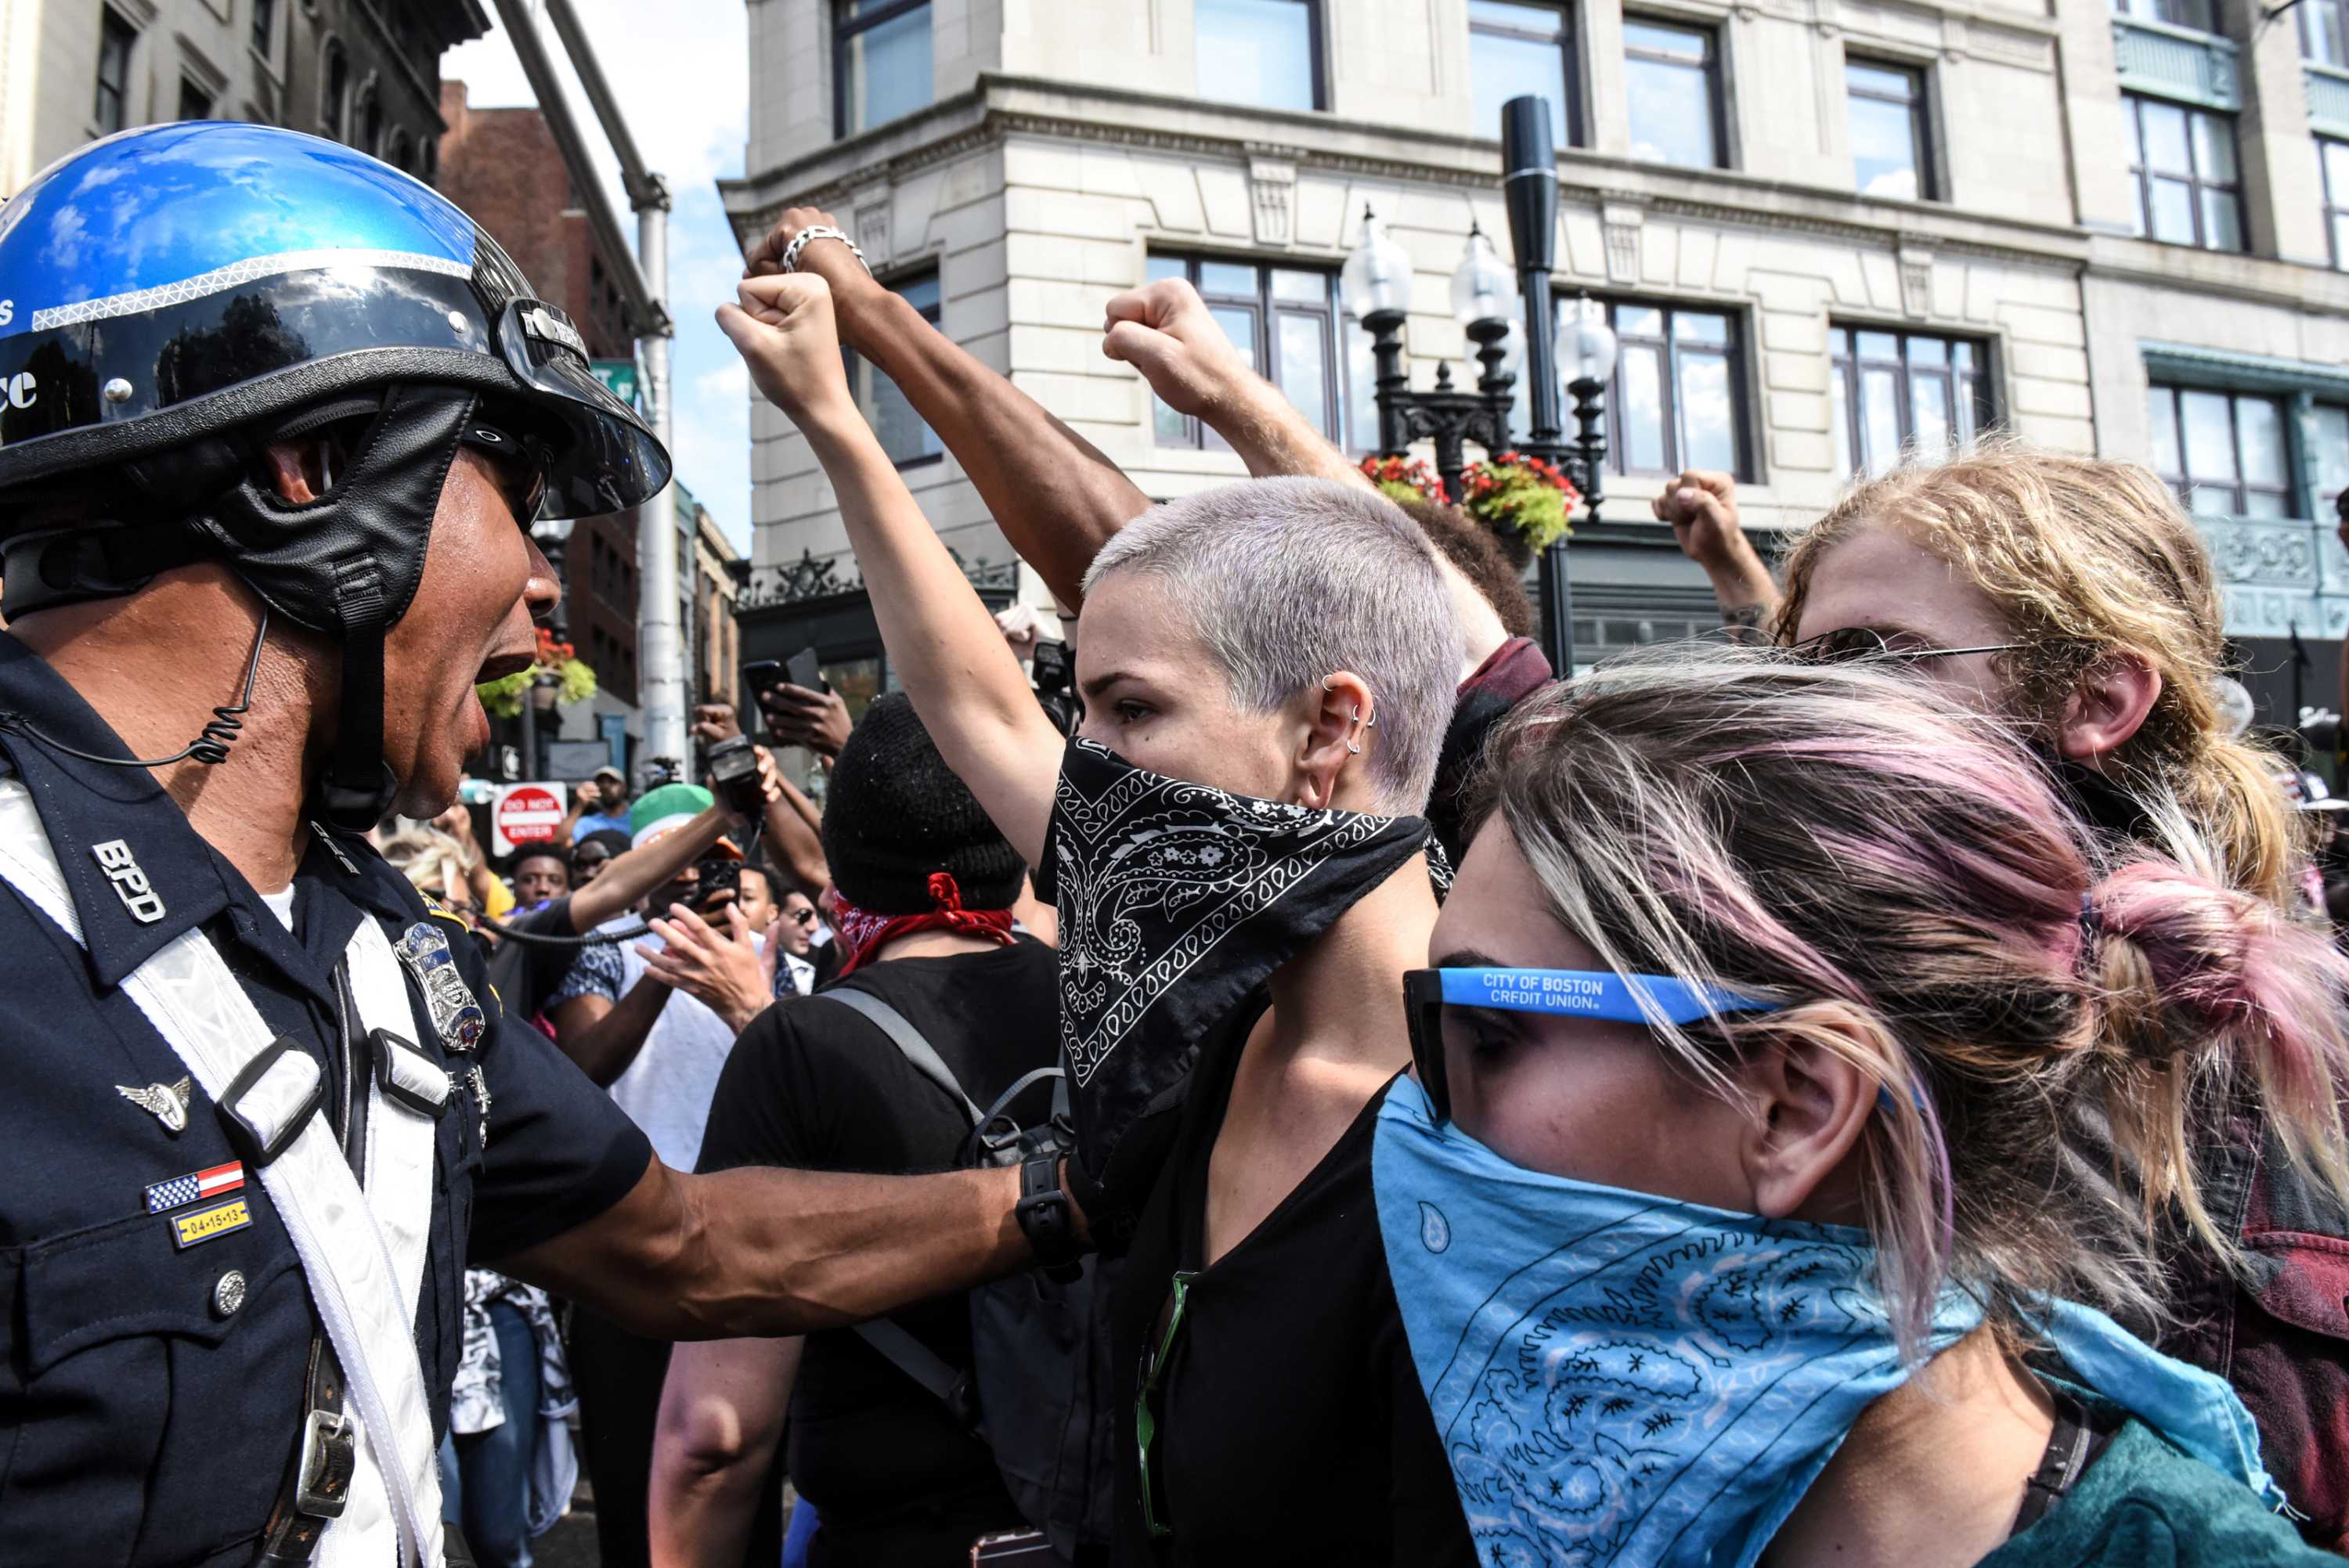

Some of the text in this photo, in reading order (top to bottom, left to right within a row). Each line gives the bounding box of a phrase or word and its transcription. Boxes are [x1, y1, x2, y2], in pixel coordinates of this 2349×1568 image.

[503, 798, 554, 811] DO NOT
[509, 826, 552, 838] ENTER
[92, 839, 166, 923] BPD
[1483, 973, 1603, 996] CITY OF BOSTON
[1491, 989, 1542, 1005] CREDIT
